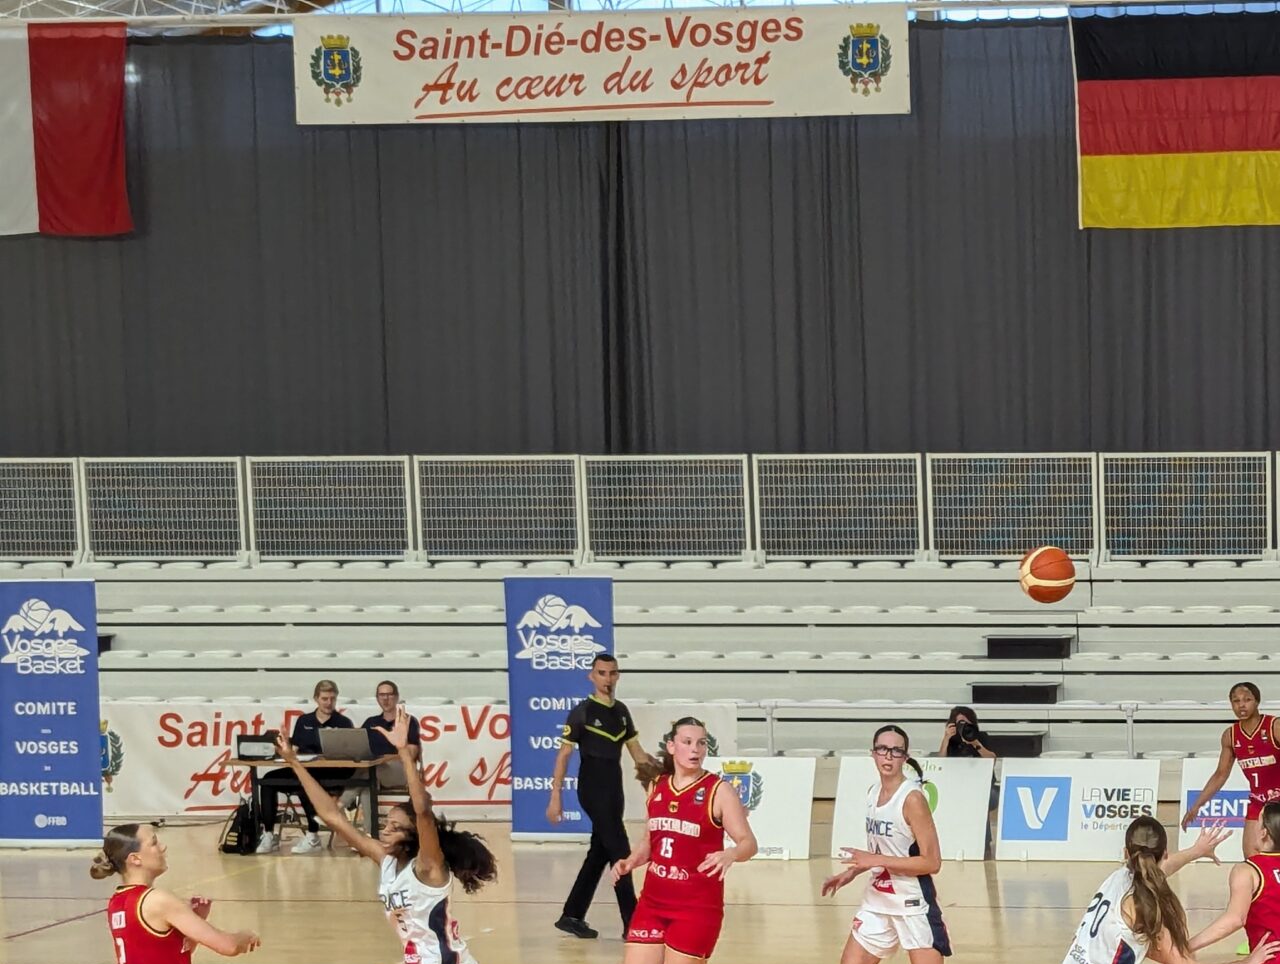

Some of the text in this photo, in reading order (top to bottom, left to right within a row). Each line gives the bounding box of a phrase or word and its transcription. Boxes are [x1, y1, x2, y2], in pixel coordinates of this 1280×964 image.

[393, 15, 804, 61] Saint-Dié-des-Vosges
[414, 51, 773, 109] Au cœur du sport
[3, 634, 78, 659] Vosges
[517, 629, 594, 654] Vosges
[16, 655, 85, 674] Basket
[14, 701, 77, 716] COMITE
[15, 741, 79, 755] VOSGES
[0, 782, 99, 796] BASKETBALL
[1081, 787, 1153, 802] LA VIE EN
[1083, 804, 1152, 819] VOSGES
[660, 837, 674, 859] 15
